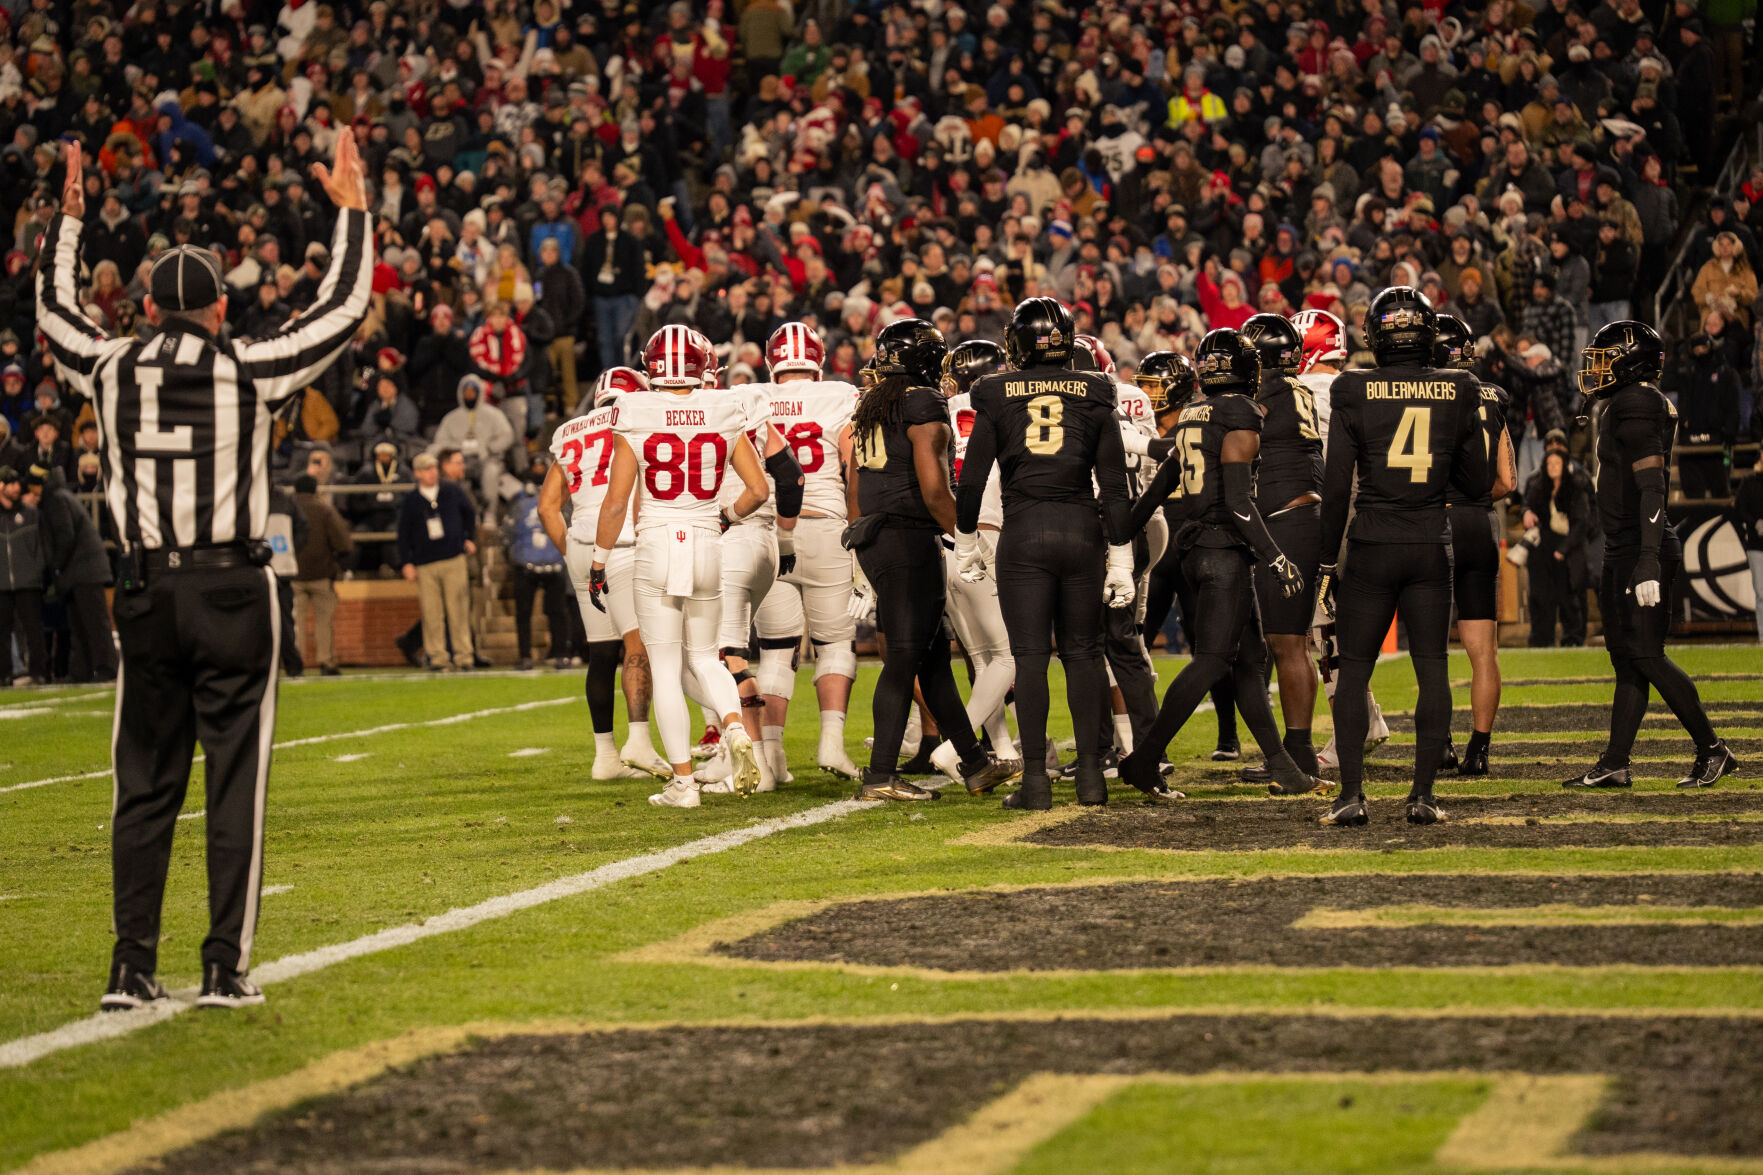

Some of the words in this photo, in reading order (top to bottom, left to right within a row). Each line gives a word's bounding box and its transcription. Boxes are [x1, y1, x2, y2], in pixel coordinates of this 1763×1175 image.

[955, 348, 974, 369] 91
[135, 366, 193, 451] L
[665, 409, 706, 426] BECKER
[1005, 380, 1088, 398] BOILERMAKERS
[1121, 399, 1144, 416] 72
[1366, 381, 1456, 400] BOILERMAKERS
[1025, 395, 1064, 455] 8
[1387, 407, 1433, 483] 4
[560, 428, 614, 495] 37
[643, 432, 727, 501] 80
[1175, 427, 1206, 495] 15
